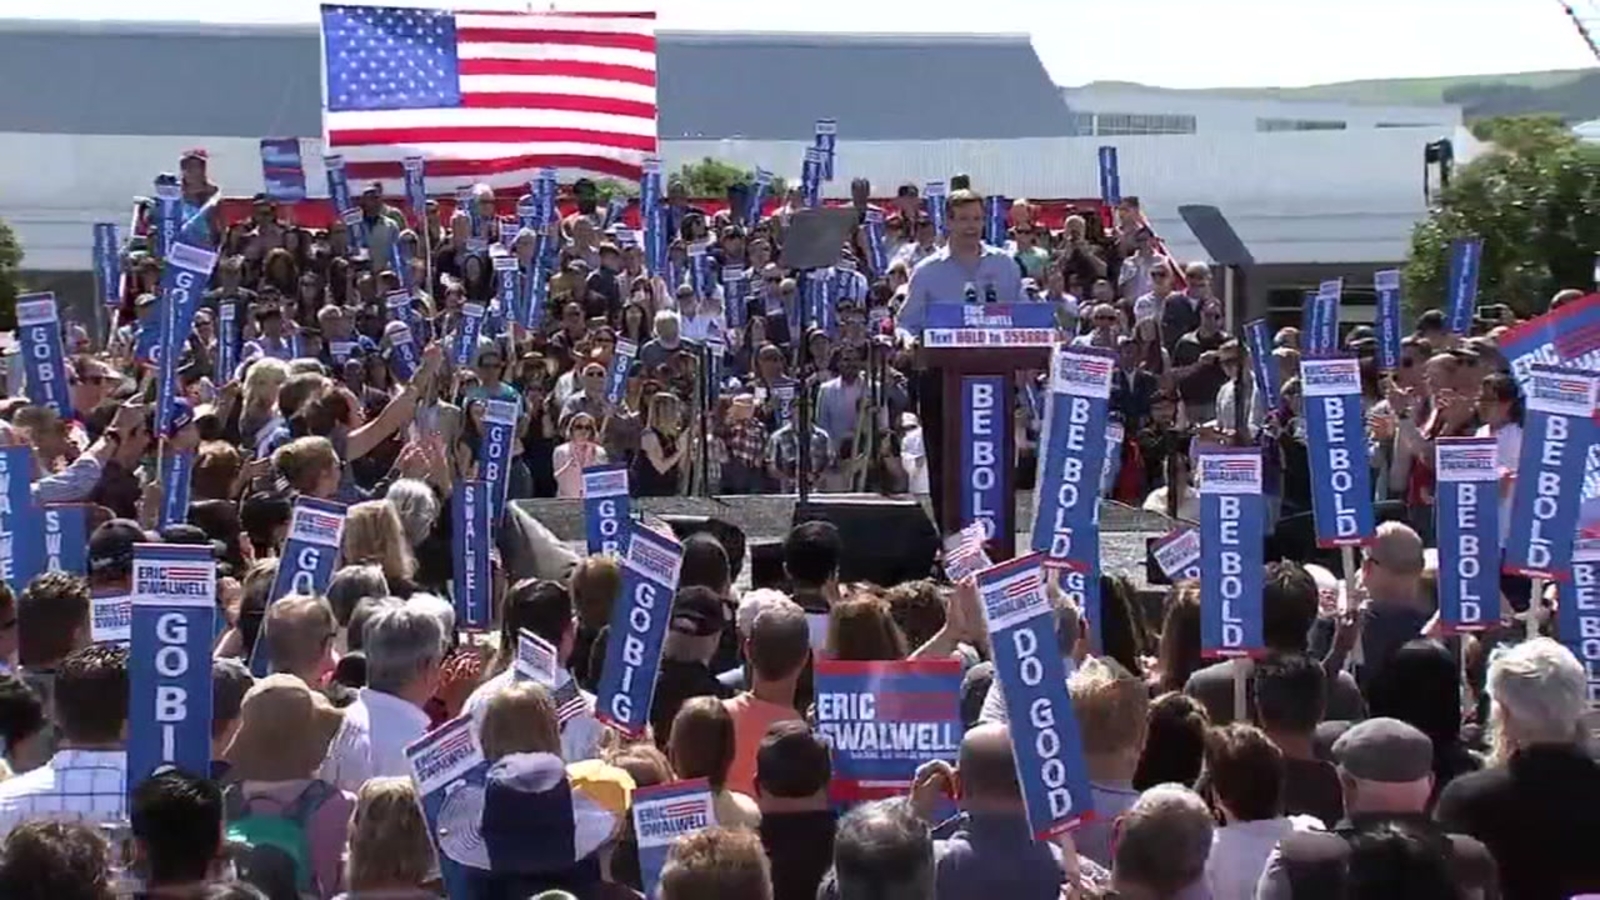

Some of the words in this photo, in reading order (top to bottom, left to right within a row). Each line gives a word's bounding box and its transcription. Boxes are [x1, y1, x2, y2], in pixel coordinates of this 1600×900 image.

[32, 326, 51, 359] GO
[972, 383, 994, 434] BE
[1067, 398, 1091, 450] BE
[1324, 397, 1346, 443] BE
[1542, 415, 1568, 465] BE
[1050, 457, 1084, 558] BOLD
[1329, 448, 1358, 537] BOLD
[1457, 483, 1478, 528] BE
[599, 500, 618, 536] GO
[1219, 496, 1241, 545] BE
[1527, 471, 1561, 568] BOLD
[138, 566, 168, 580] ERIC
[138, 580, 209, 596] SWALWELL
[1458, 535, 1481, 623] BOLD
[1573, 564, 1597, 610] BE
[630, 583, 656, 633] GO
[1220, 552, 1244, 647] BOLD
[155, 612, 189, 677] GO
[612, 634, 645, 723] BIG
[817, 692, 876, 721] ERIC
[1012, 628, 1043, 686] DO
[1030, 698, 1073, 820] GOOD
[817, 721, 959, 751] SWALWELL
[638, 807, 668, 823] ERIC
[640, 814, 708, 838] SWALWELL
